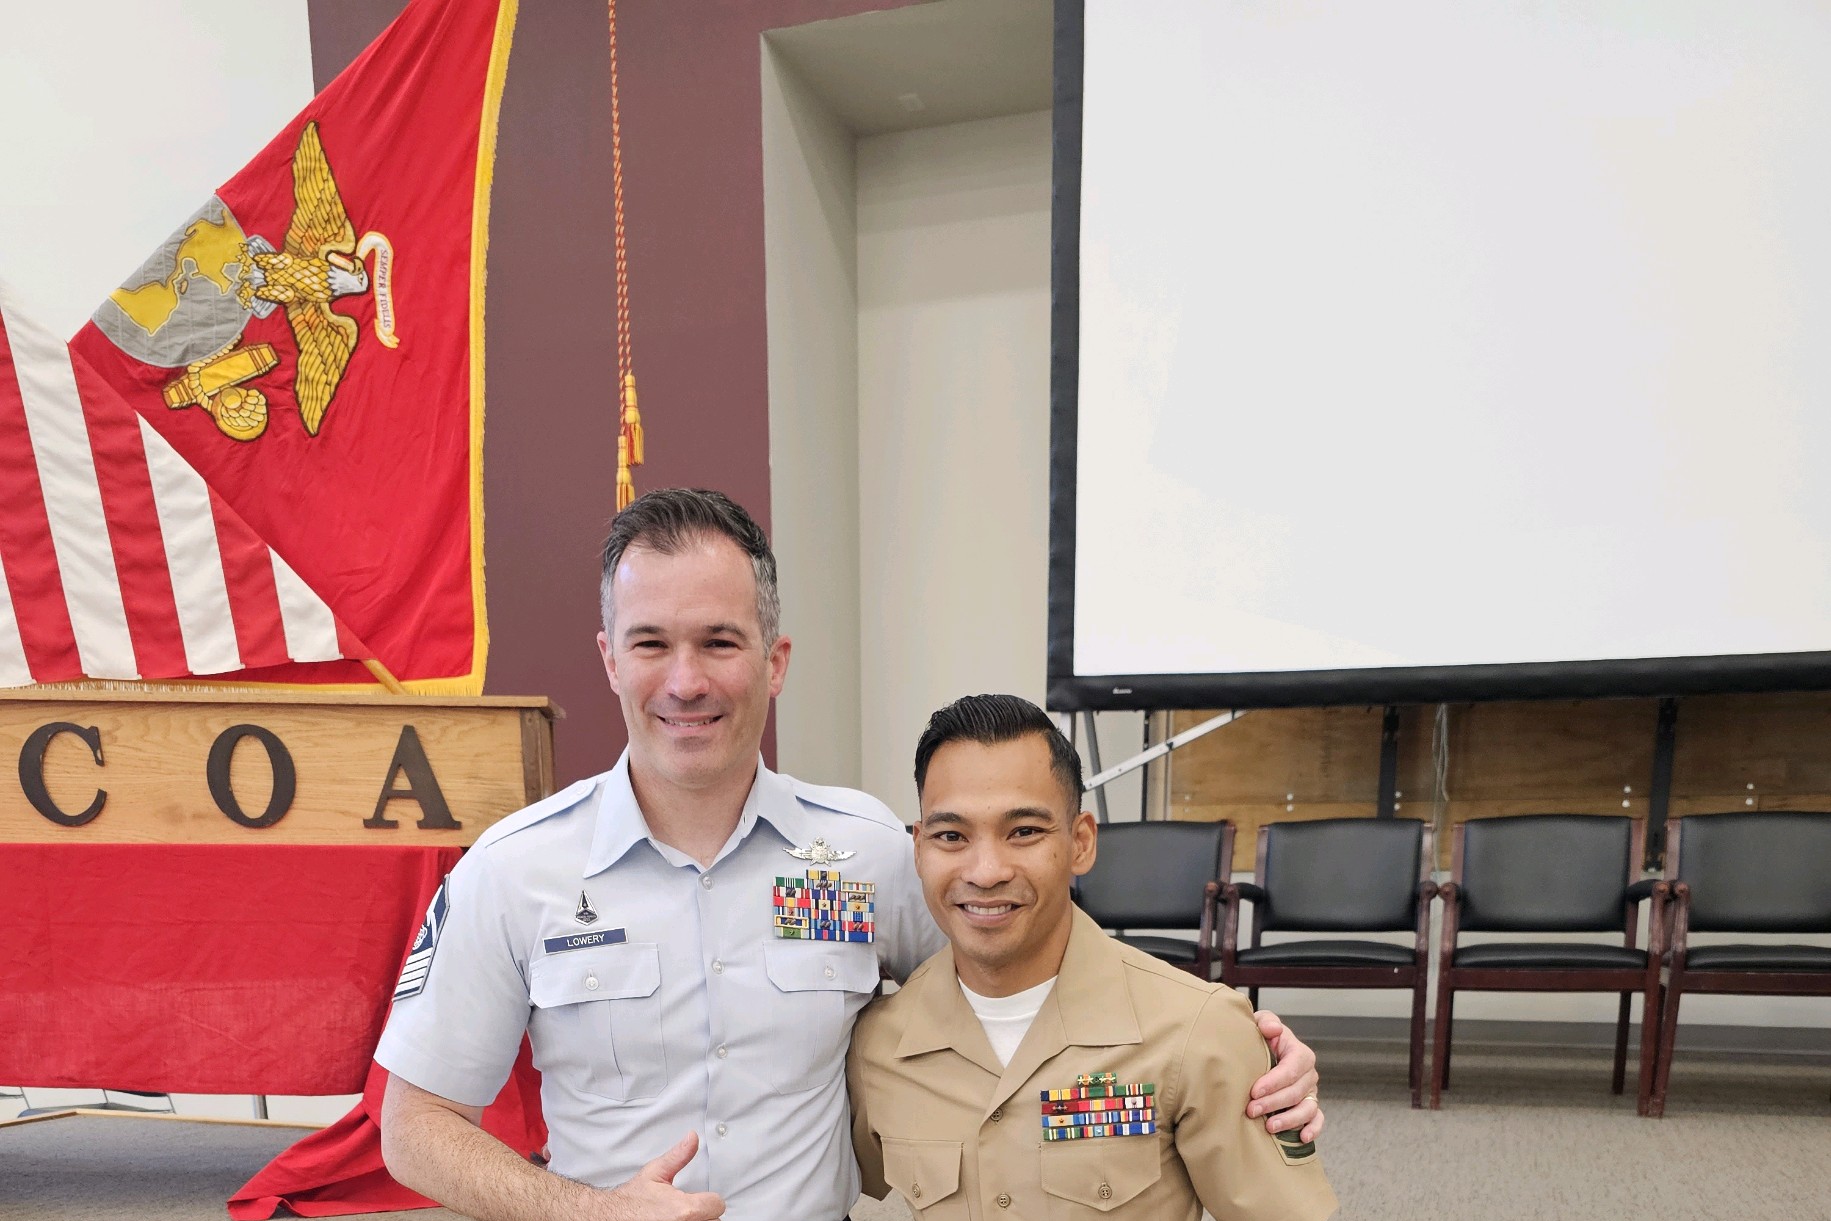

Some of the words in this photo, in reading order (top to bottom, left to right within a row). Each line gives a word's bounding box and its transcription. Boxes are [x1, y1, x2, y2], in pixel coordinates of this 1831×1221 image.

[378, 249, 389, 288] SEMPER
[380, 293, 391, 329] FIDELIS
[566, 934, 605, 947] LOWERY
